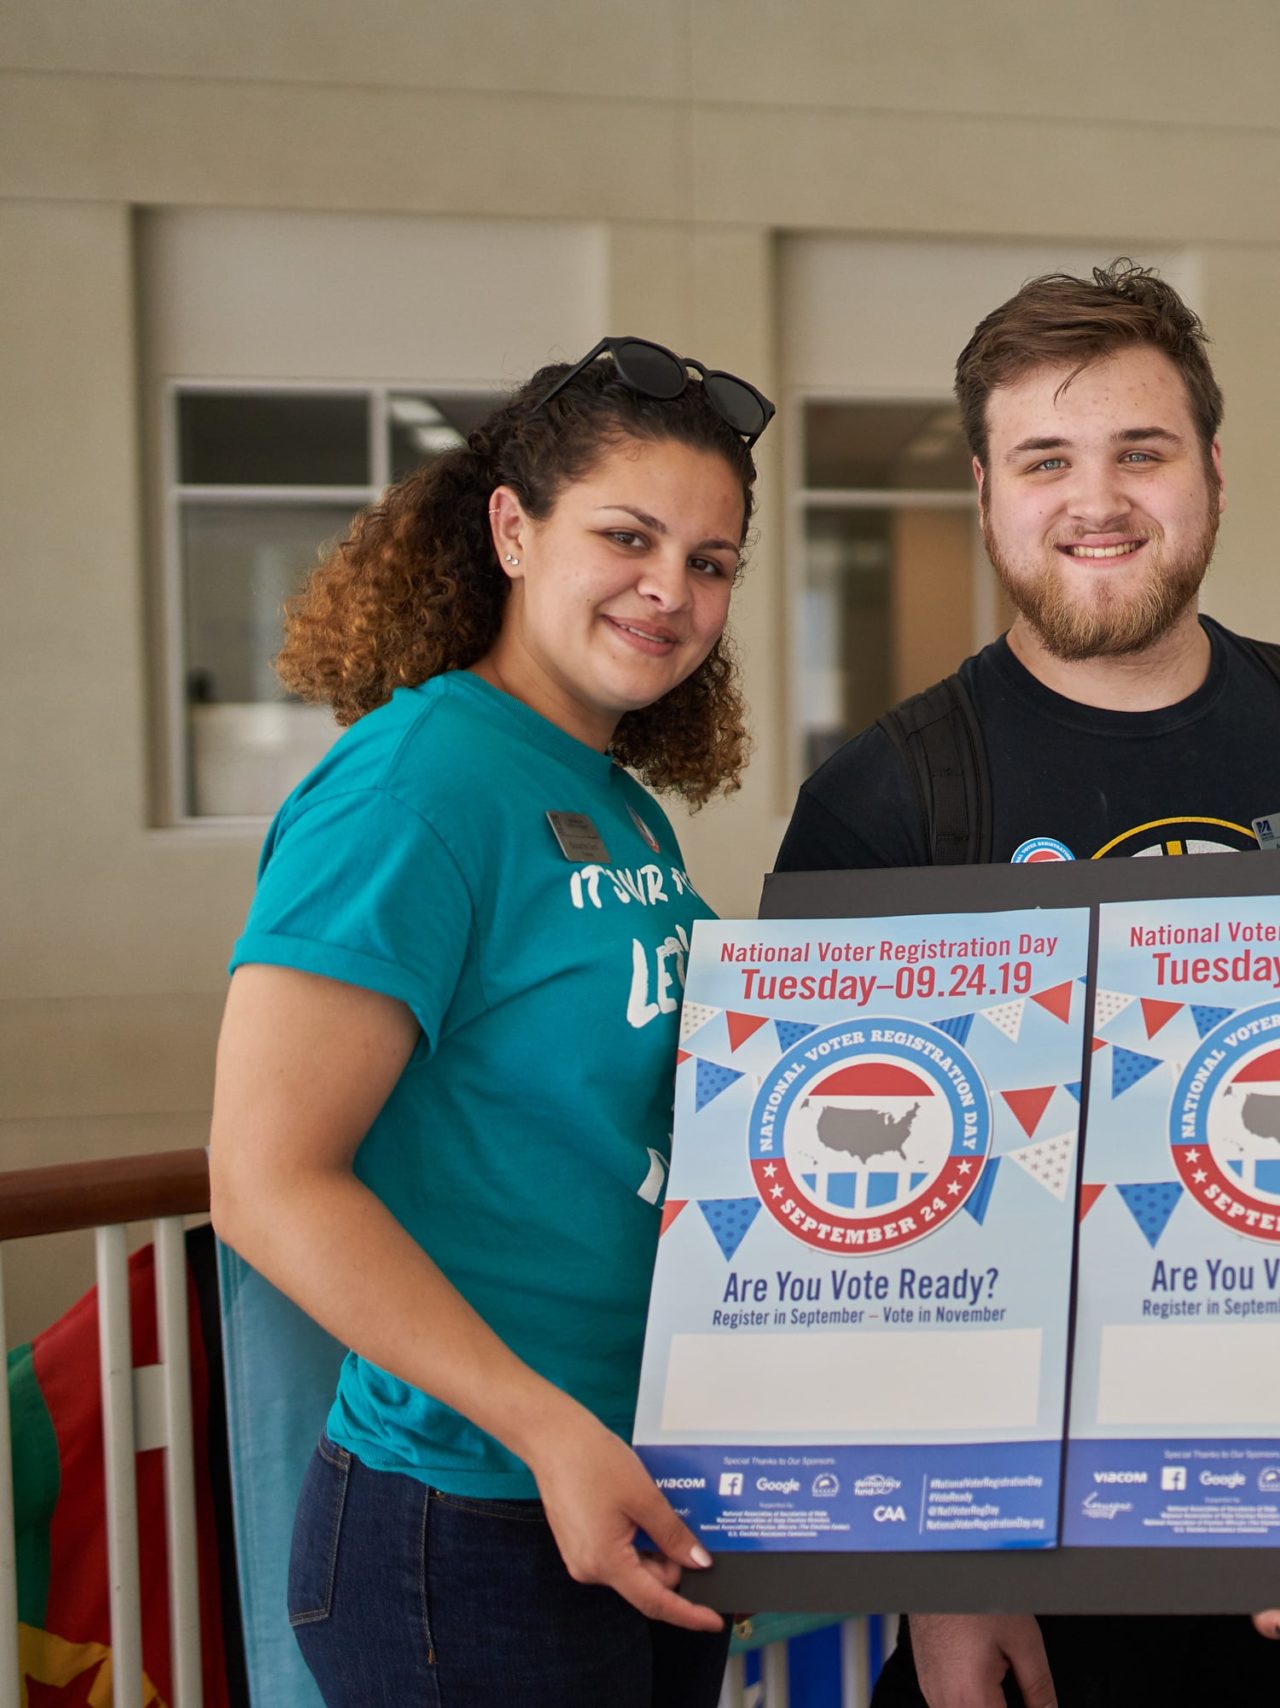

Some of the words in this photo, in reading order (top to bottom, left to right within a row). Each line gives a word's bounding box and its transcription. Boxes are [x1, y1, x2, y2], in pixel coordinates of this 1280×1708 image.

[1129, 922, 1220, 947] National
[720, 940, 810, 963] National
[817, 942, 875, 962] Voter
[879, 937, 1011, 965] Registration
[1019, 934, 1059, 958] Day
[759, 1061, 806, 1153] NATIONAL
[804, 1030, 865, 1062] VOTER
[871, 1029, 976, 1108] REGISTRATION
[962, 1110, 977, 1151] DAY
[1181, 1048, 1228, 1138] NATIONAL
[780, 1198, 918, 1246] SEPTEMBER
[919, 1196, 948, 1221] 24
[723, 1271, 767, 1303] Are
[776, 1271, 821, 1301] You
[831, 1269, 889, 1300] Vote
[900, 1267, 1000, 1307] Ready?
[1151, 1260, 1199, 1293] Are
[1206, 1259, 1254, 1291] You
[712, 1310, 769, 1329] Register
[773, 1309, 787, 1325] in
[791, 1307, 865, 1329] September
[883, 1307, 915, 1323] Vote
[919, 1307, 932, 1323] in
[935, 1305, 1007, 1323] November
[1142, 1299, 1201, 1318] Register
[1206, 1298, 1220, 1315] in
[752, 1456, 778, 1465] Thanks
[757, 1478, 800, 1494] Google
[1200, 1470, 1247, 1488] Google
[873, 1506, 906, 1522] CAA
